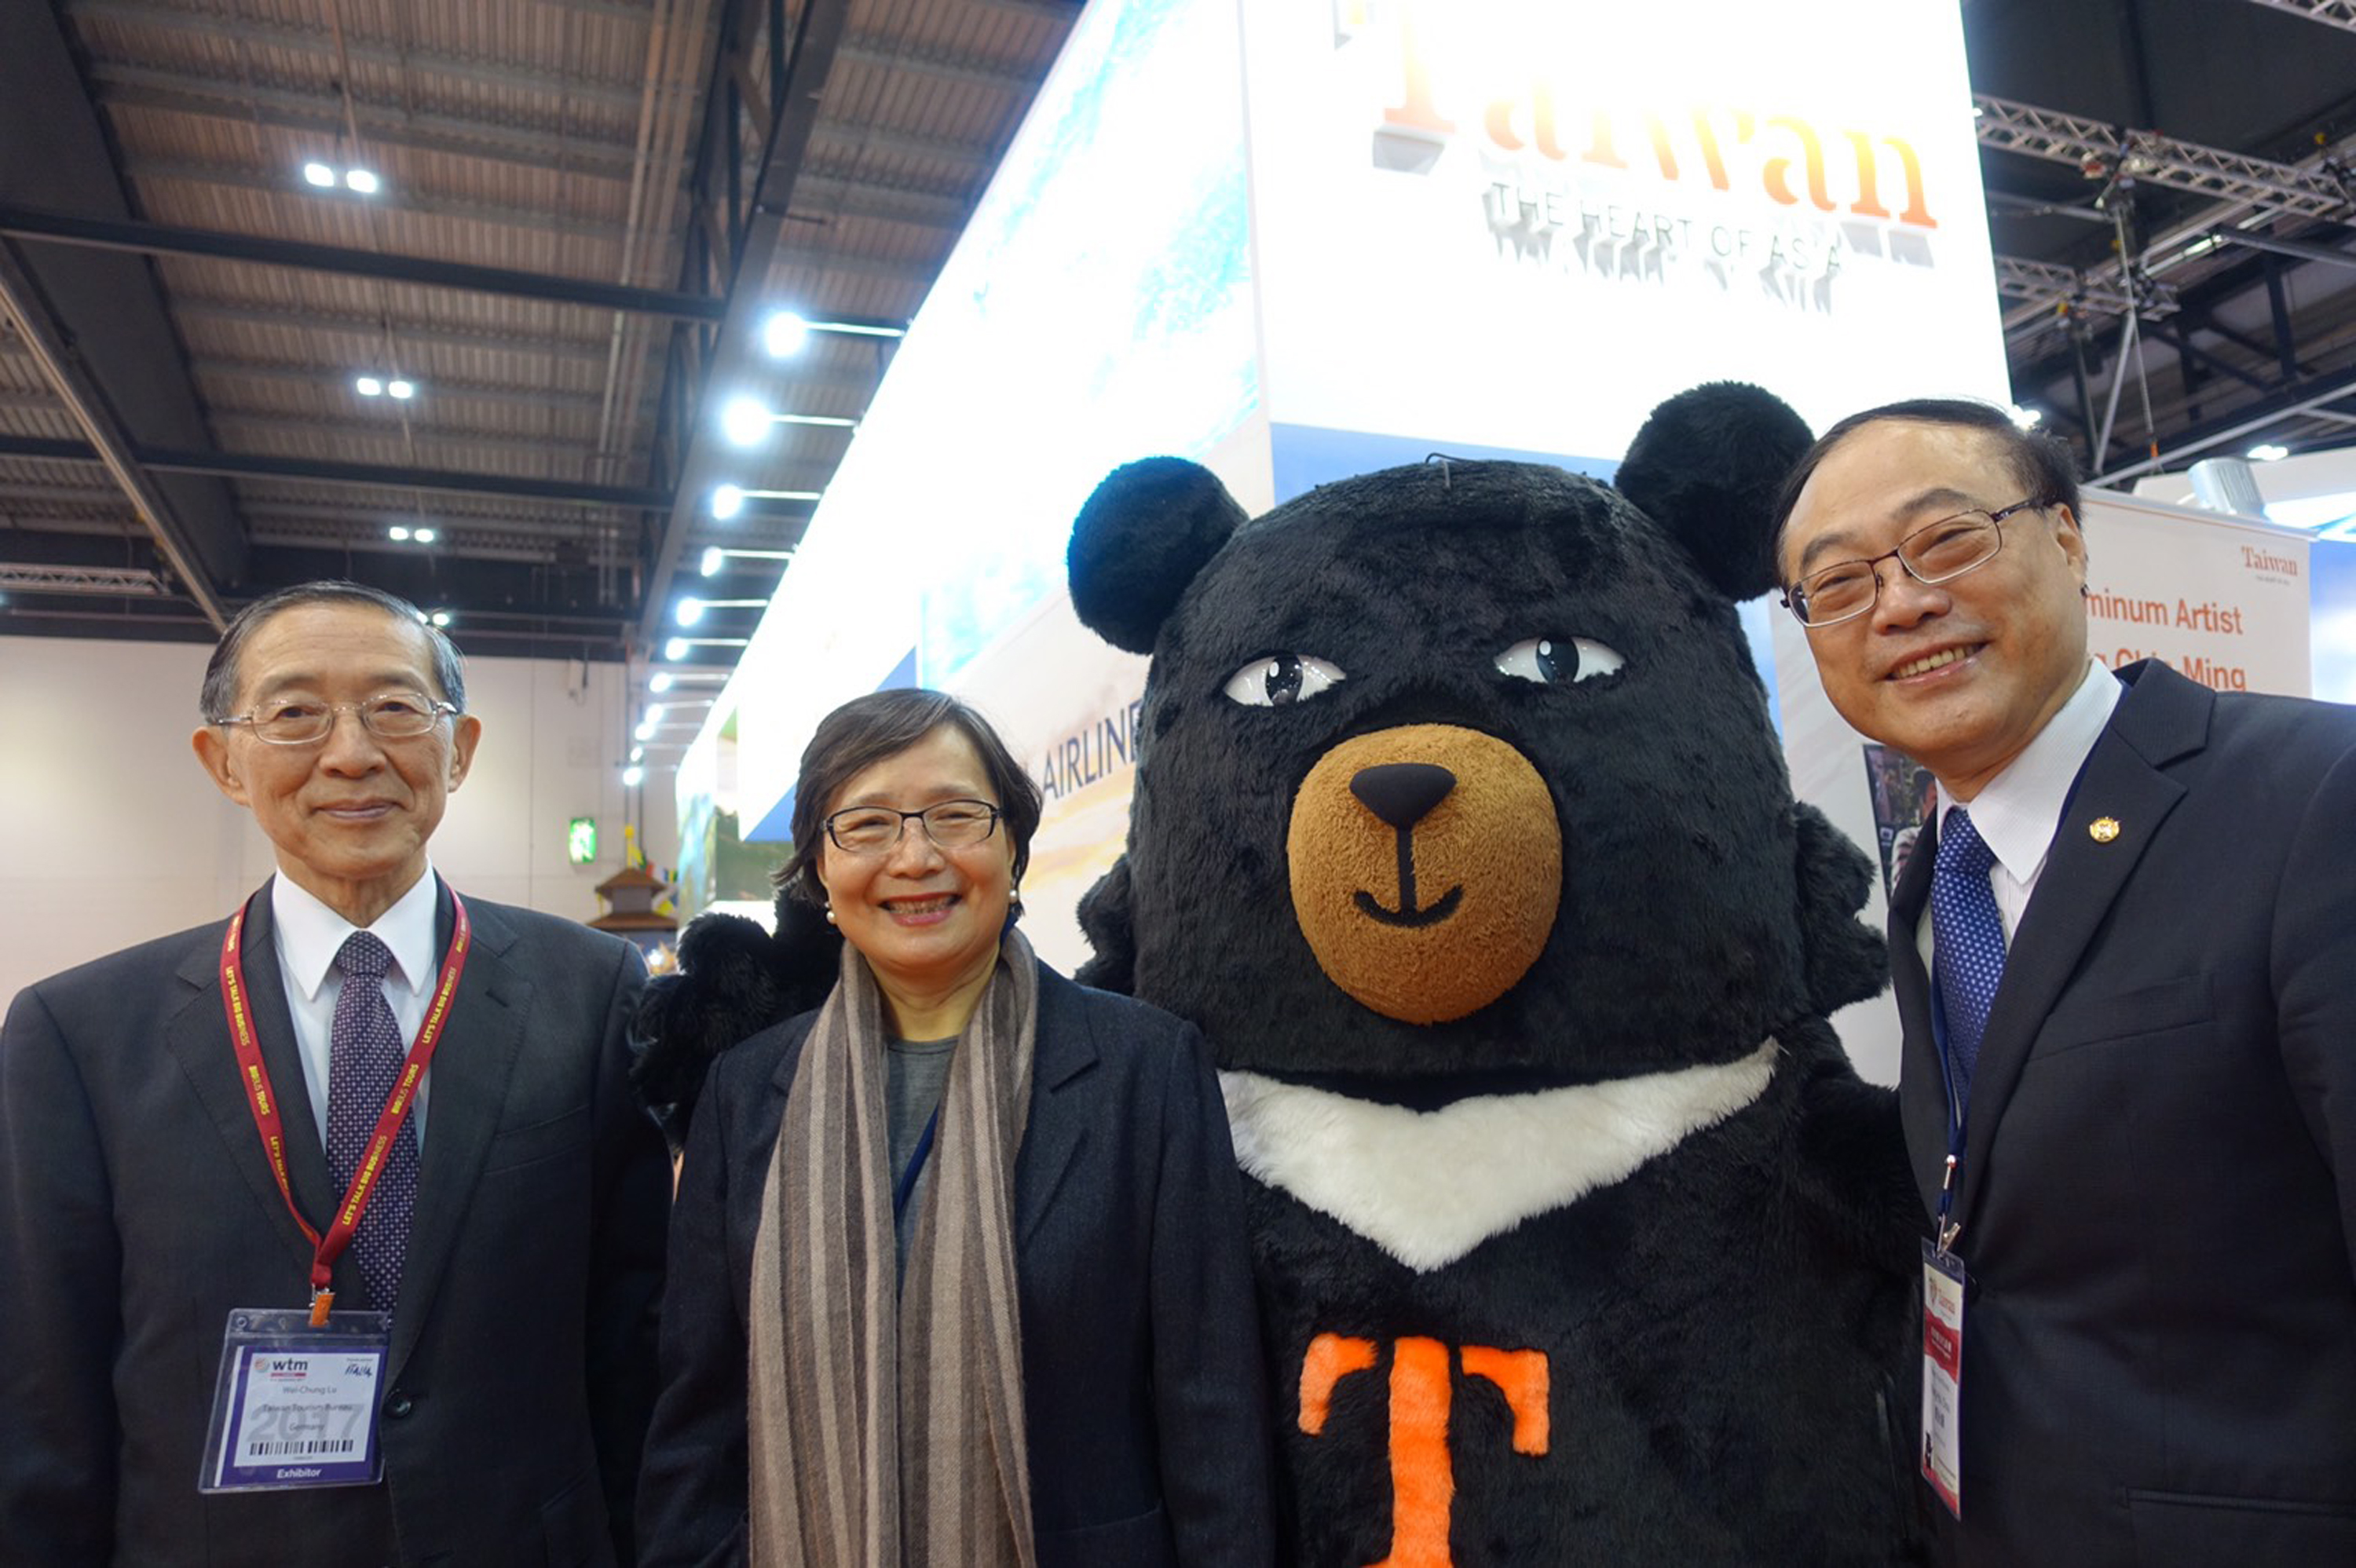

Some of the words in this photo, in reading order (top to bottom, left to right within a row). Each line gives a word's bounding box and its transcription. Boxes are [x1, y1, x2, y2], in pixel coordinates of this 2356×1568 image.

[1492, 182, 1564, 225] THE
[1580, 199, 1692, 250] HEART
[1713, 225, 1754, 257] OF
[2241, 545, 2298, 577] Taiwan
[2175, 598, 2243, 634] Artist
[342, 1204, 356, 1225] LET'S
[351, 1184, 365, 1203] TALK
[360, 1171, 371, 1184] BIG
[273, 1358, 308, 1371] wtm
[1297, 1332, 1549, 1568] T
[276, 1468, 322, 1478] Exhibitor
